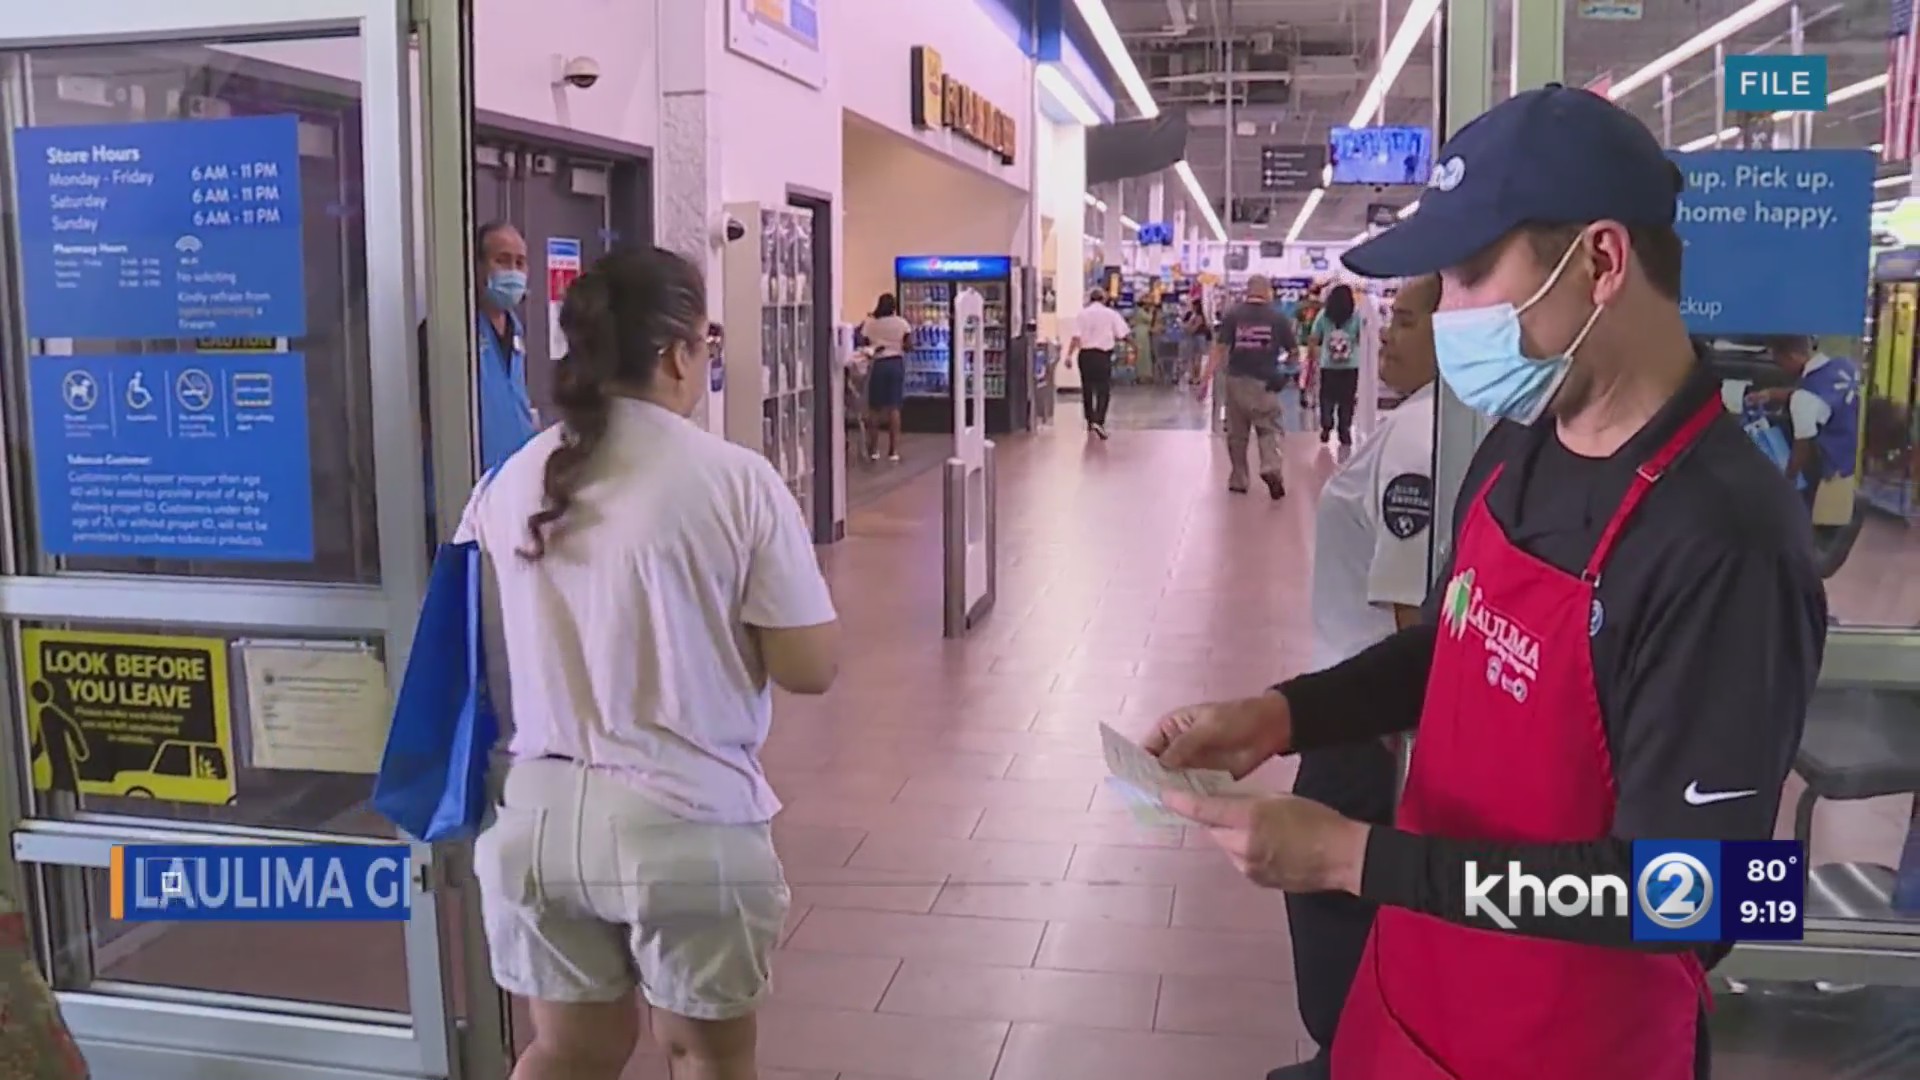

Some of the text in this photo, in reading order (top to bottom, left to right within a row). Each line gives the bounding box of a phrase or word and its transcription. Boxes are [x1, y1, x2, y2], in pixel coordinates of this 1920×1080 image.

[47, 145, 140, 164] Store Hours
[49, 172, 100, 189] Monday
[112, 168, 154, 187] Friday
[191, 166, 202, 181] 6
[204, 165, 229, 181] AM
[241, 163, 252, 179] 11
[254, 162, 278, 178] PM
[1689, 164, 1835, 194] up. Pick up.
[50, 194, 107, 211] Saturday
[192, 188, 203, 204] 6
[204, 188, 230, 203] AM
[242, 186, 253, 201] 11
[255, 185, 280, 200] PM
[52, 215, 98, 234] Sunday
[193, 211, 204, 226] 6
[205, 210, 231, 225] AM
[243, 209, 254, 224] 11
[256, 207, 281, 223] PM
[1676, 200, 1838, 229] home happy.
[53, 243, 128, 255] Pharmacy Hours
[68, 470, 119, 483] Customers
[1467, 586, 1540, 671] LAULIMA
[45, 649, 206, 681] LOOK BEFORE
[66, 678, 192, 709] YOU LEAVE
